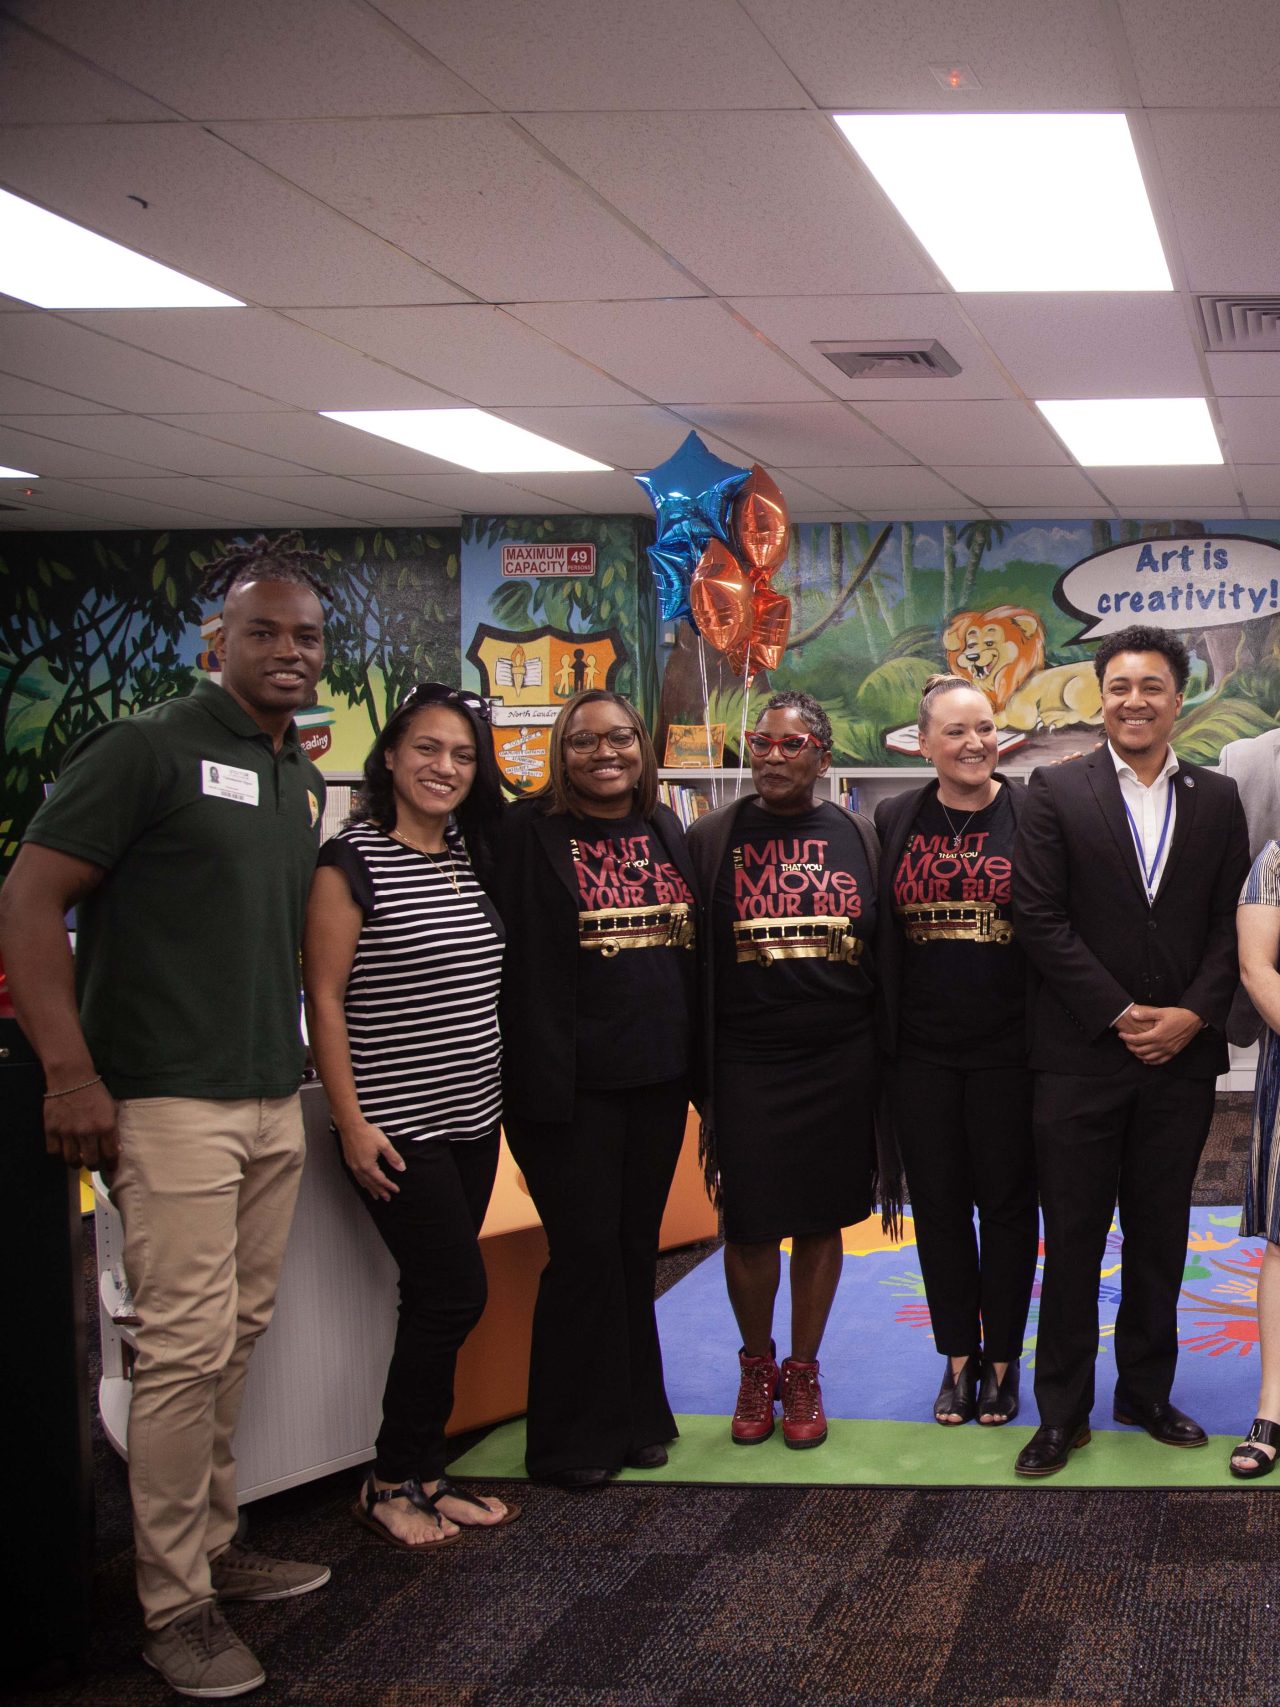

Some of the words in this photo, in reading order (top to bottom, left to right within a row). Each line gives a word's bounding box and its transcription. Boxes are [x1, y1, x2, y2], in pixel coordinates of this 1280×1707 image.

[506, 548, 564, 561] MAXIMUM
[571, 551, 588, 563] 49
[1136, 543, 1195, 573] Art
[1203, 541, 1228, 571] is
[505, 561, 566, 573] CAPACITY
[1097, 578, 1279, 614] creativity!
[507, 709, 531, 718] North
[300, 734, 328, 751] eading
[577, 835, 650, 863] MUST
[743, 839, 828, 868] MUST
[910, 832, 990, 854] MUST
[960, 851, 978, 859] YOU
[780, 863, 802, 872] THAT
[803, 863, 822, 872] YOU
[579, 885, 648, 912] YOUR
[893, 877, 952, 905] YOUR
[961, 877, 1013, 905] BUS
[735, 892, 803, 919] YOUR
[812, 891, 862, 918] BUS
